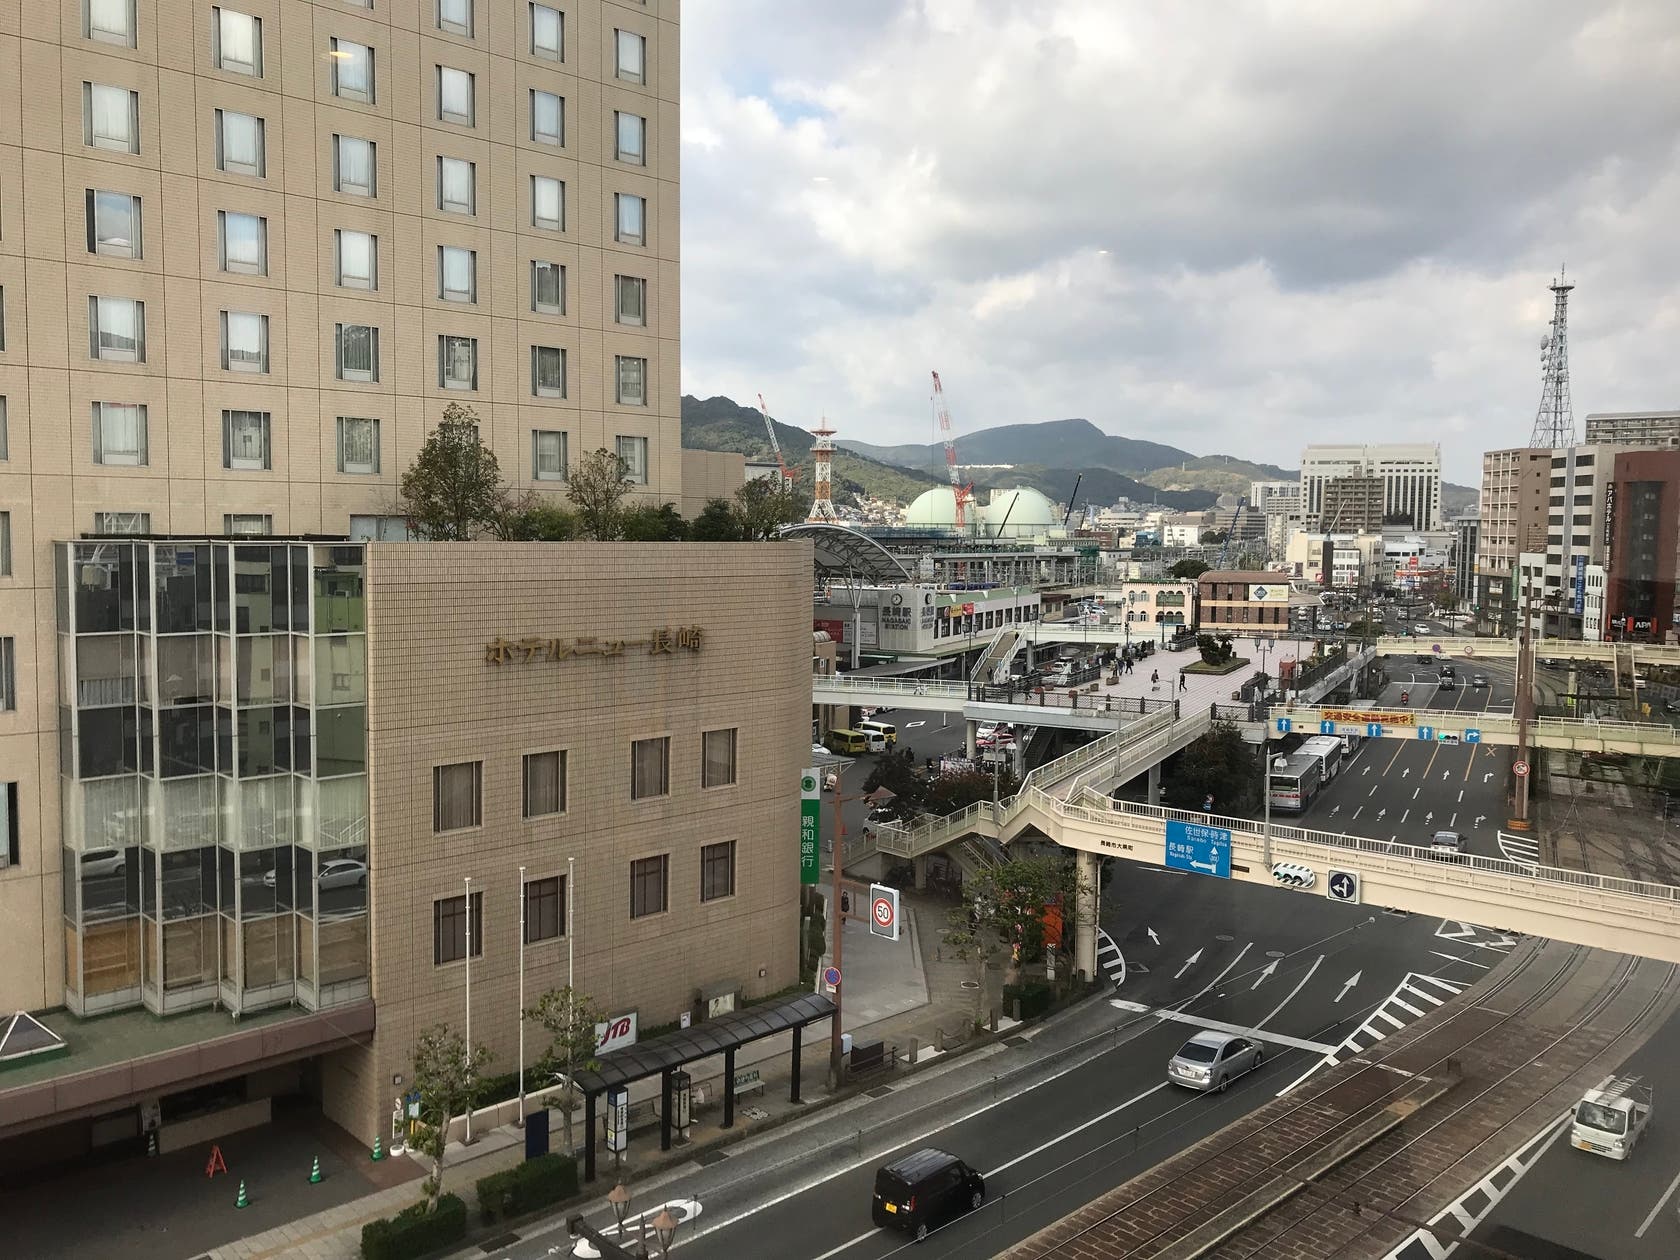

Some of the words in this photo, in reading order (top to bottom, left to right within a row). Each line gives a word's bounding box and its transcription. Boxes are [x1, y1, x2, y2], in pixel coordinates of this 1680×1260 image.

[486, 624, 706, 665] ホテルニュー長崎
[801, 815, 815, 868] 親和銀行
[1168, 842, 1194, 854] 長崎駅
[877, 905, 889, 919] 50
[601, 1016, 631, 1047] JTB
